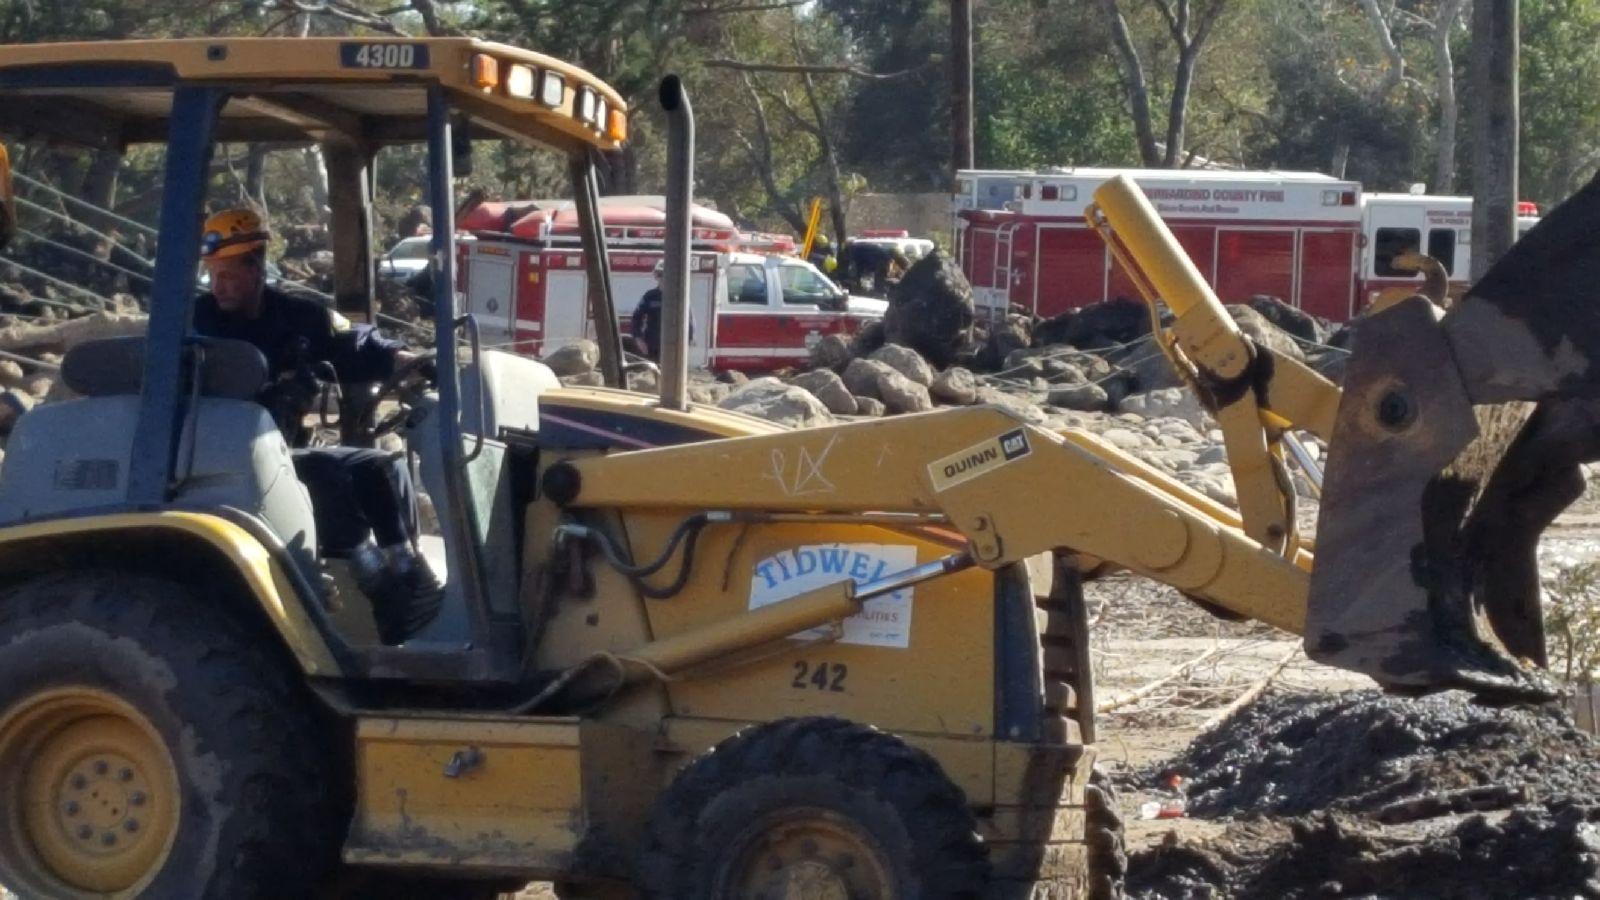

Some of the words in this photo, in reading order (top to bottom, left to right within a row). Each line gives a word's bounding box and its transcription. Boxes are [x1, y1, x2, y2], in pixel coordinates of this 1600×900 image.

[356, 44, 414, 67] 430D
[1143, 188, 1210, 200] ERNARDINO
[1213, 189, 1258, 201] COUNTY
[1259, 190, 1284, 202] FIRE
[944, 447, 998, 477] QUINN
[1003, 433, 1025, 455] CAT
[757, 548, 902, 599] TIDWEL
[791, 661, 847, 692] 242
